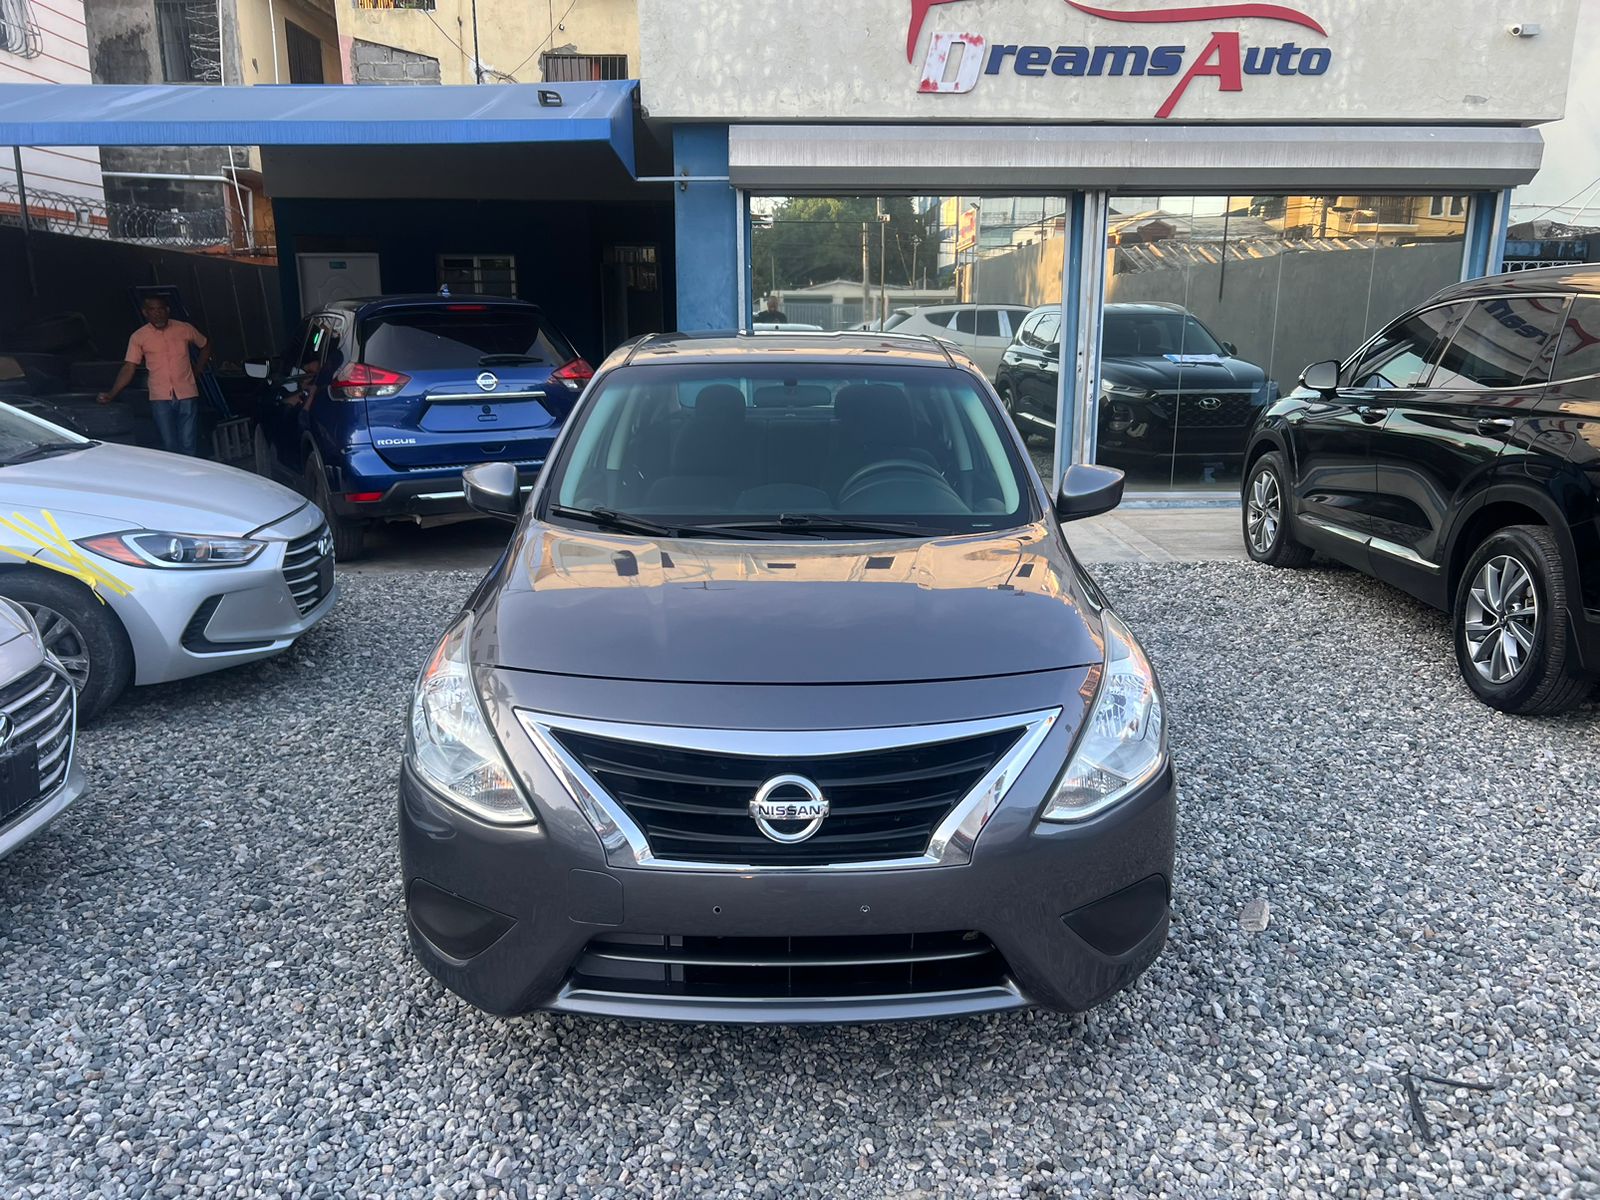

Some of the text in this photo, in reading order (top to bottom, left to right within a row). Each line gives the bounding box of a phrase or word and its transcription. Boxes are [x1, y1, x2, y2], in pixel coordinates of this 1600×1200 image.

[917, 32, 1332, 118] Dreams Auto
[377, 438, 416, 446] ROGUE
[758, 804, 821, 816] NISSAN
